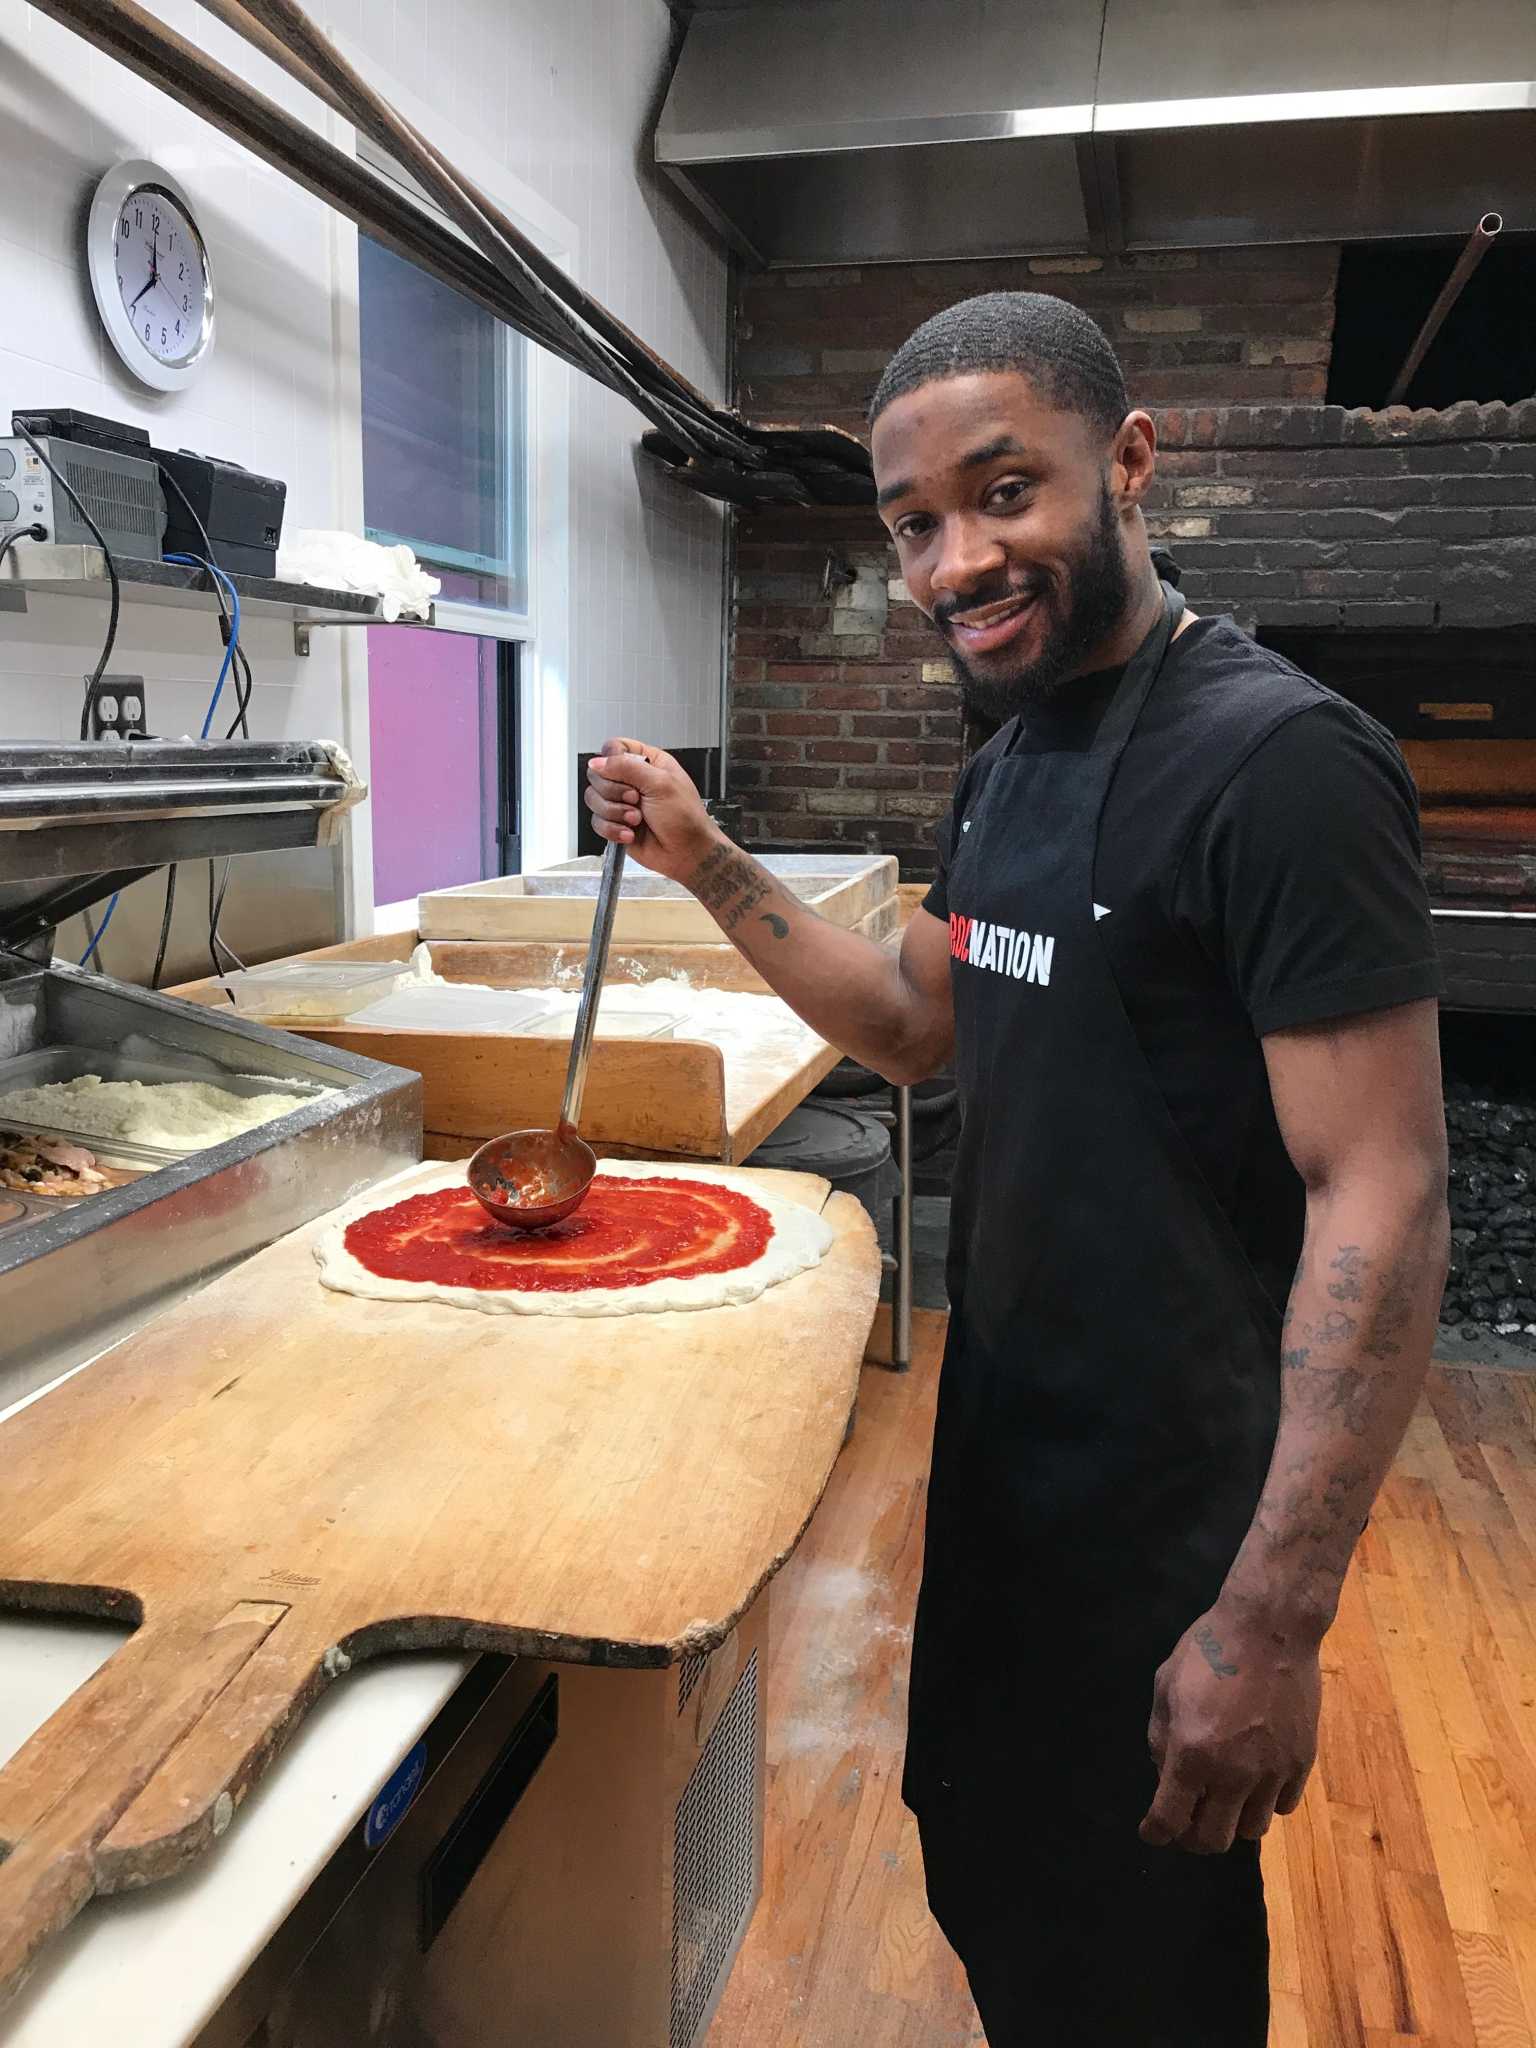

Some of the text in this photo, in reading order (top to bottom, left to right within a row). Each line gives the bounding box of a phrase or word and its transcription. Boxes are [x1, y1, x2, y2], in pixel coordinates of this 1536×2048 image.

[120, 217, 130, 239] 10
[135, 208, 143, 230] 11
[151, 214, 160, 236] 12
[168, 234, 173, 252] 1
[178, 262, 184, 281] 2
[182, 294, 188, 312] 3
[144, 323, 151, 342] 6
[160, 327, 168, 345] 5
[174, 319, 181, 336] 4
